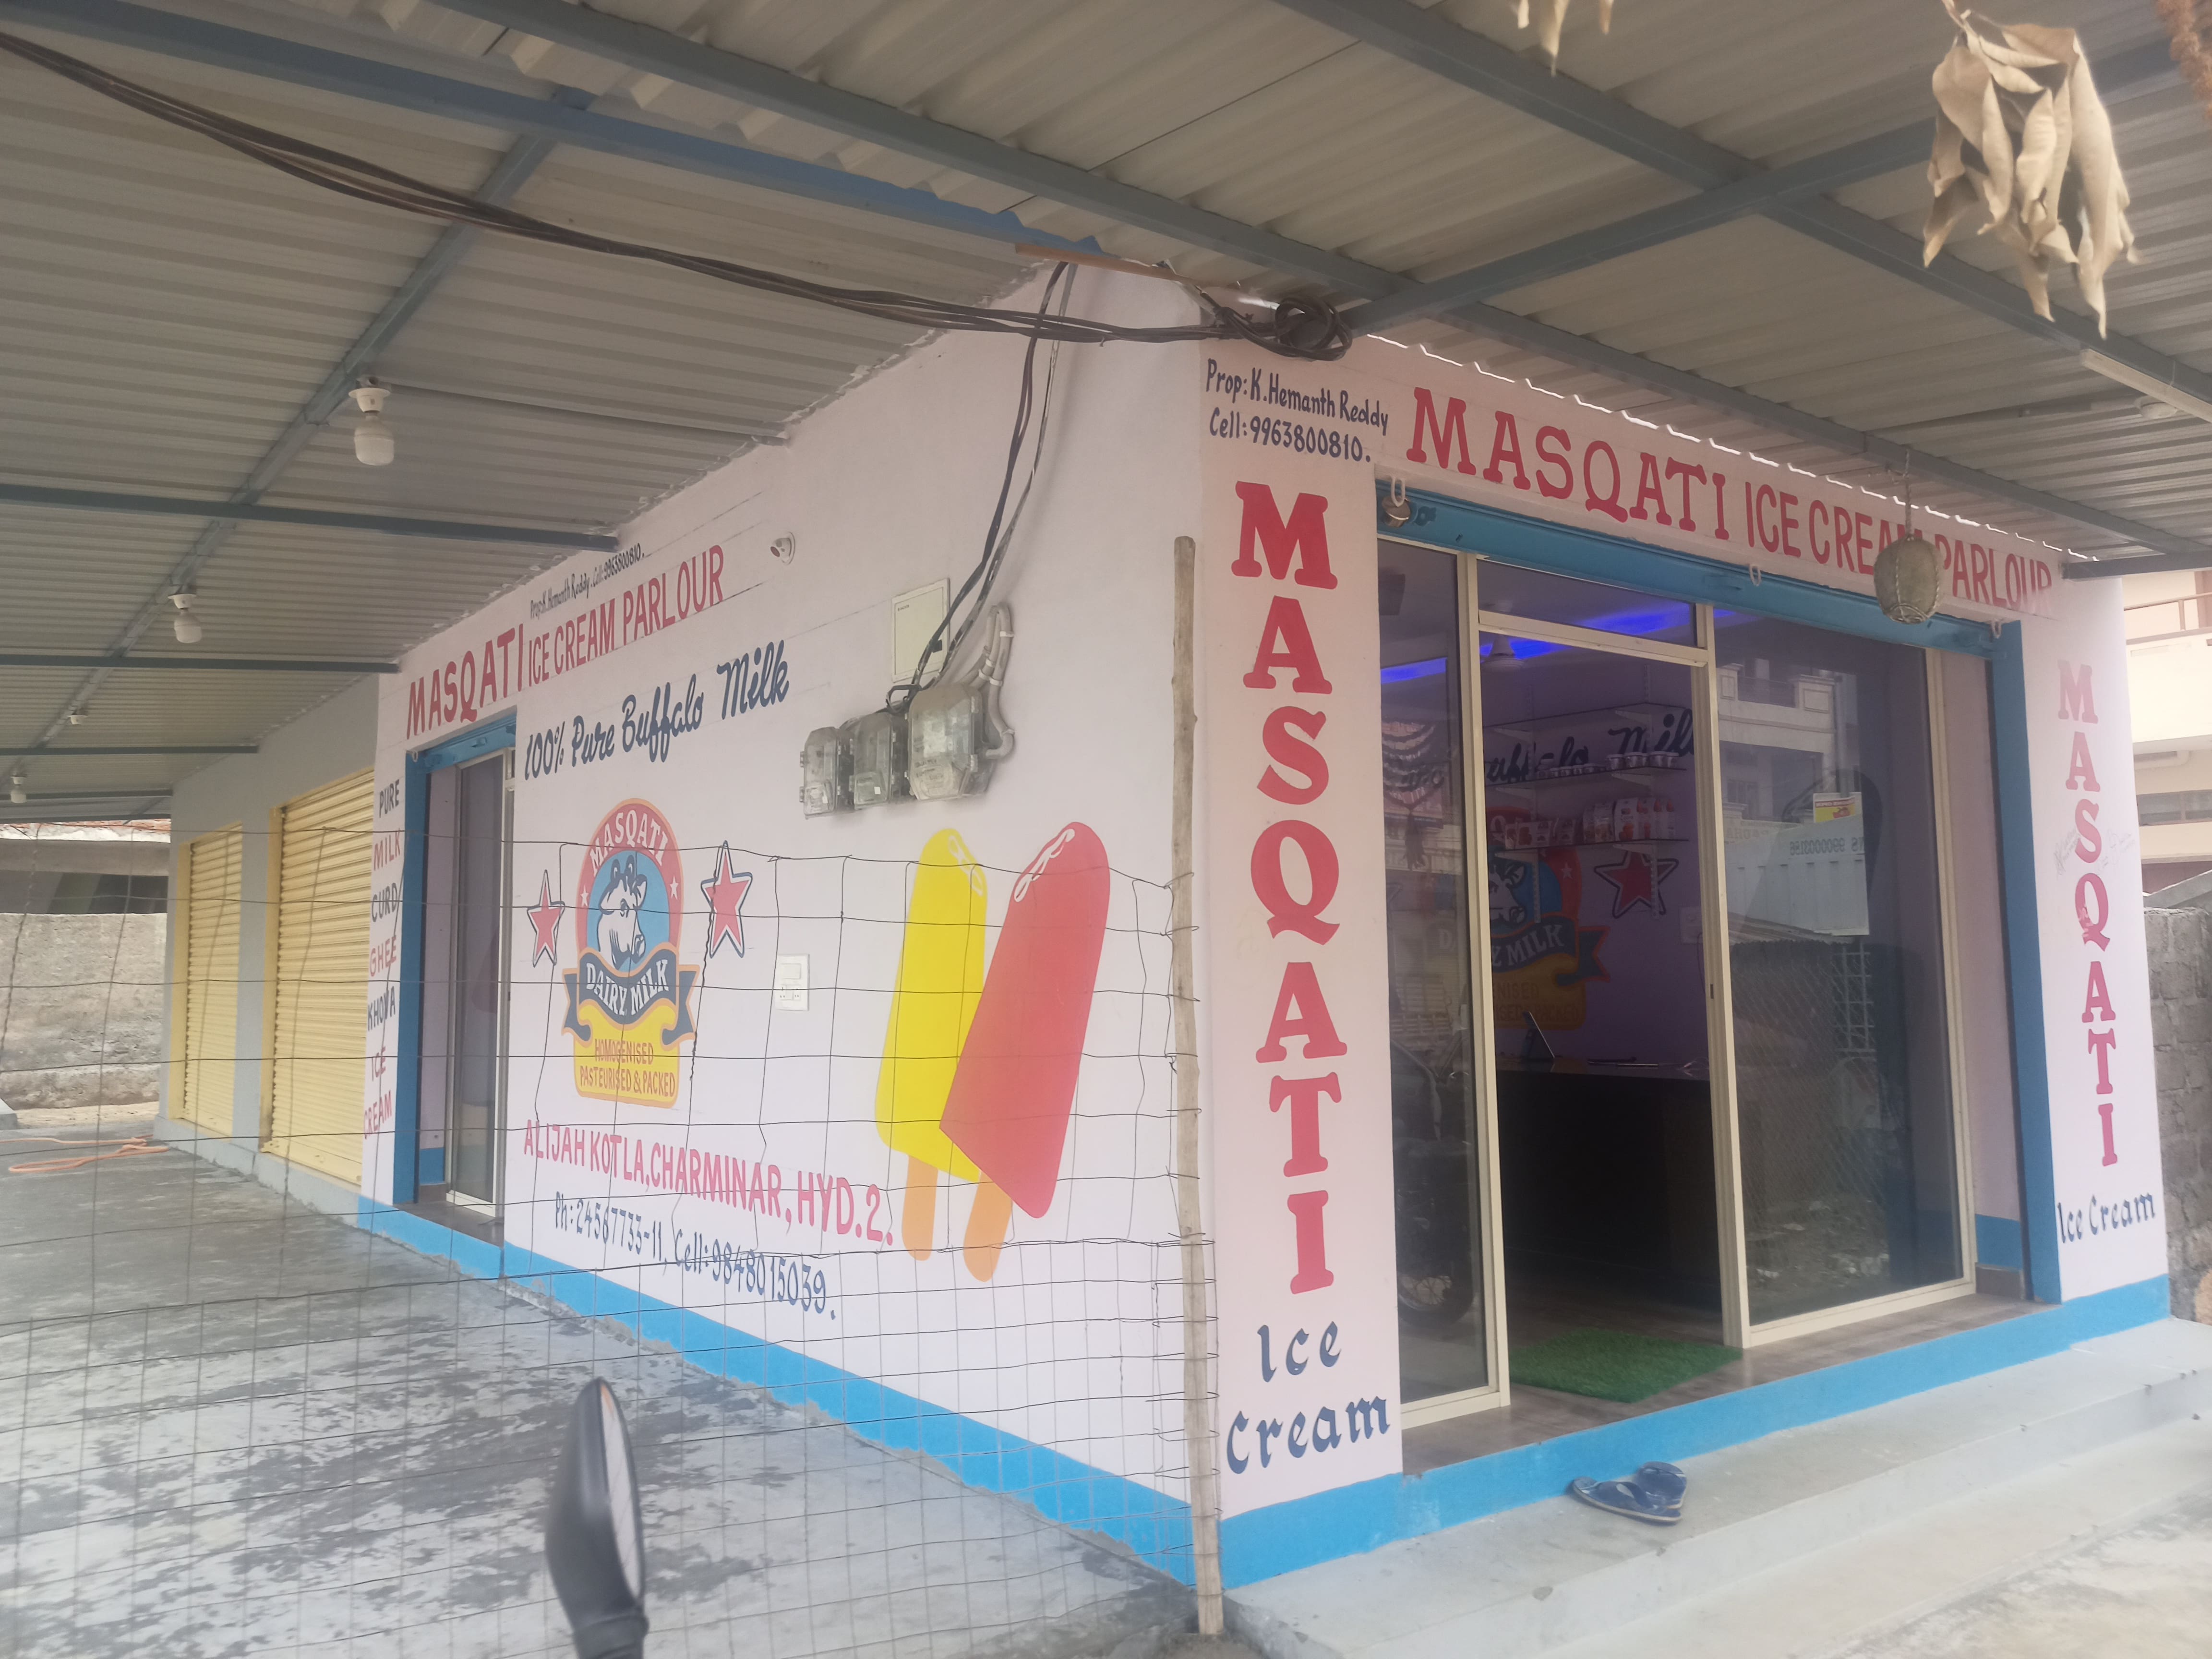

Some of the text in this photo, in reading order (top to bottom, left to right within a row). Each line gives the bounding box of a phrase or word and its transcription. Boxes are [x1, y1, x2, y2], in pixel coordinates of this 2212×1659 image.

[1340, 389, 1388, 436] Reddy
[1406, 387, 1730, 540] MASQATI
[1745, 481, 1801, 558] ICE
[406, 545, 724, 740] MASQATI ICE CREAM PARLOUR
[525, 640, 790, 781] 100% Pure Buffalo Milk
[379, 779, 400, 818] PURE
[373, 828, 401, 871] MILK
[589, 809, 668, 878] MASQATI
[371, 883, 398, 923] CURD
[369, 935, 397, 977] GHEE
[367, 986, 396, 1031] KHOVA
[586, 959, 669, 1016] DAIRY MILK
[371, 1046, 387, 1082] ICE
[595, 1038, 654, 1065] HOMOGENISED
[580, 1065, 676, 1098] PASTEURISED & PACKED
[363, 1090, 393, 1140] CREAM
[524, 1119, 585, 1167] ALIJAH
[2057, 1192, 2156, 1244] Ice Cream
[1257, 1321, 1342, 1382] Ice
[1227, 1396, 1390, 1474] Cream
